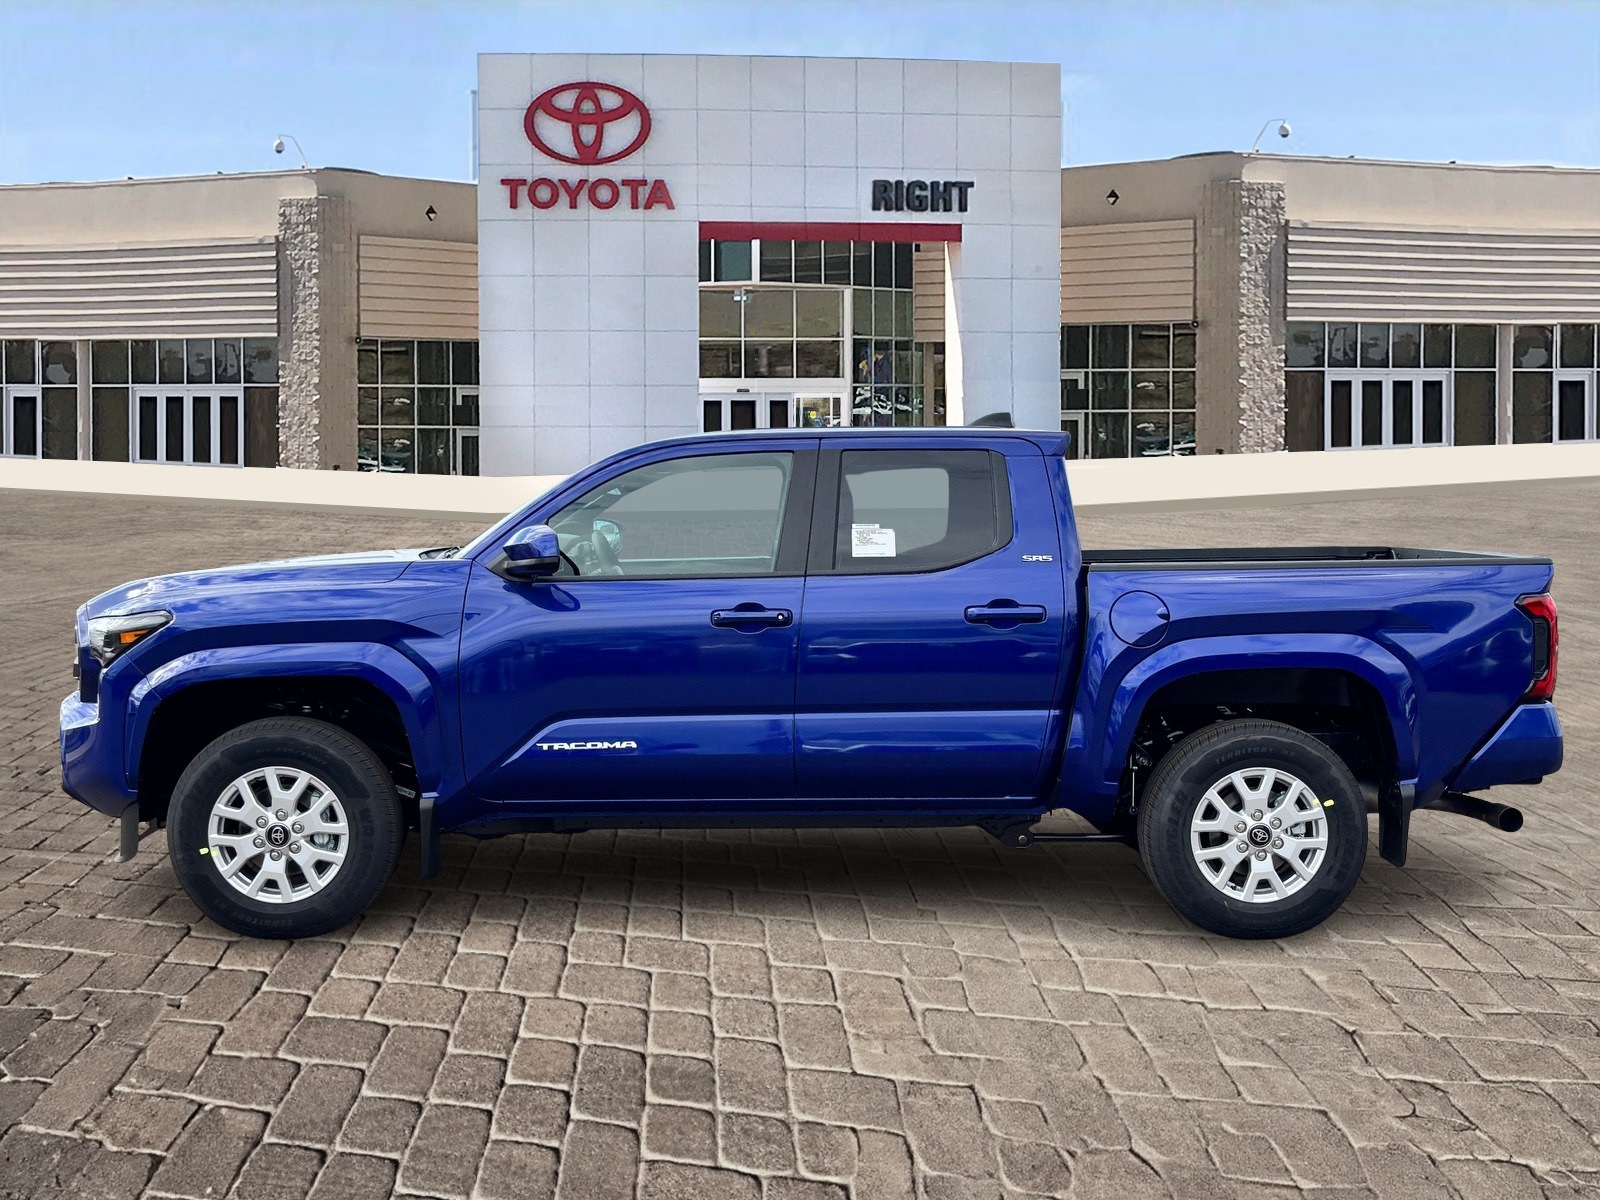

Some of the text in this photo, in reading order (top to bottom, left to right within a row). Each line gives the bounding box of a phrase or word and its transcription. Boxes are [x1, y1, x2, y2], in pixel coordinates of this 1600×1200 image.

[500, 179, 675, 210] TOYOTA
[872, 180, 975, 212] RIGHT
[1022, 554, 1053, 562] SR5
[536, 741, 638, 751] TACOMA
[1214, 747, 1274, 764] TERRITORY
